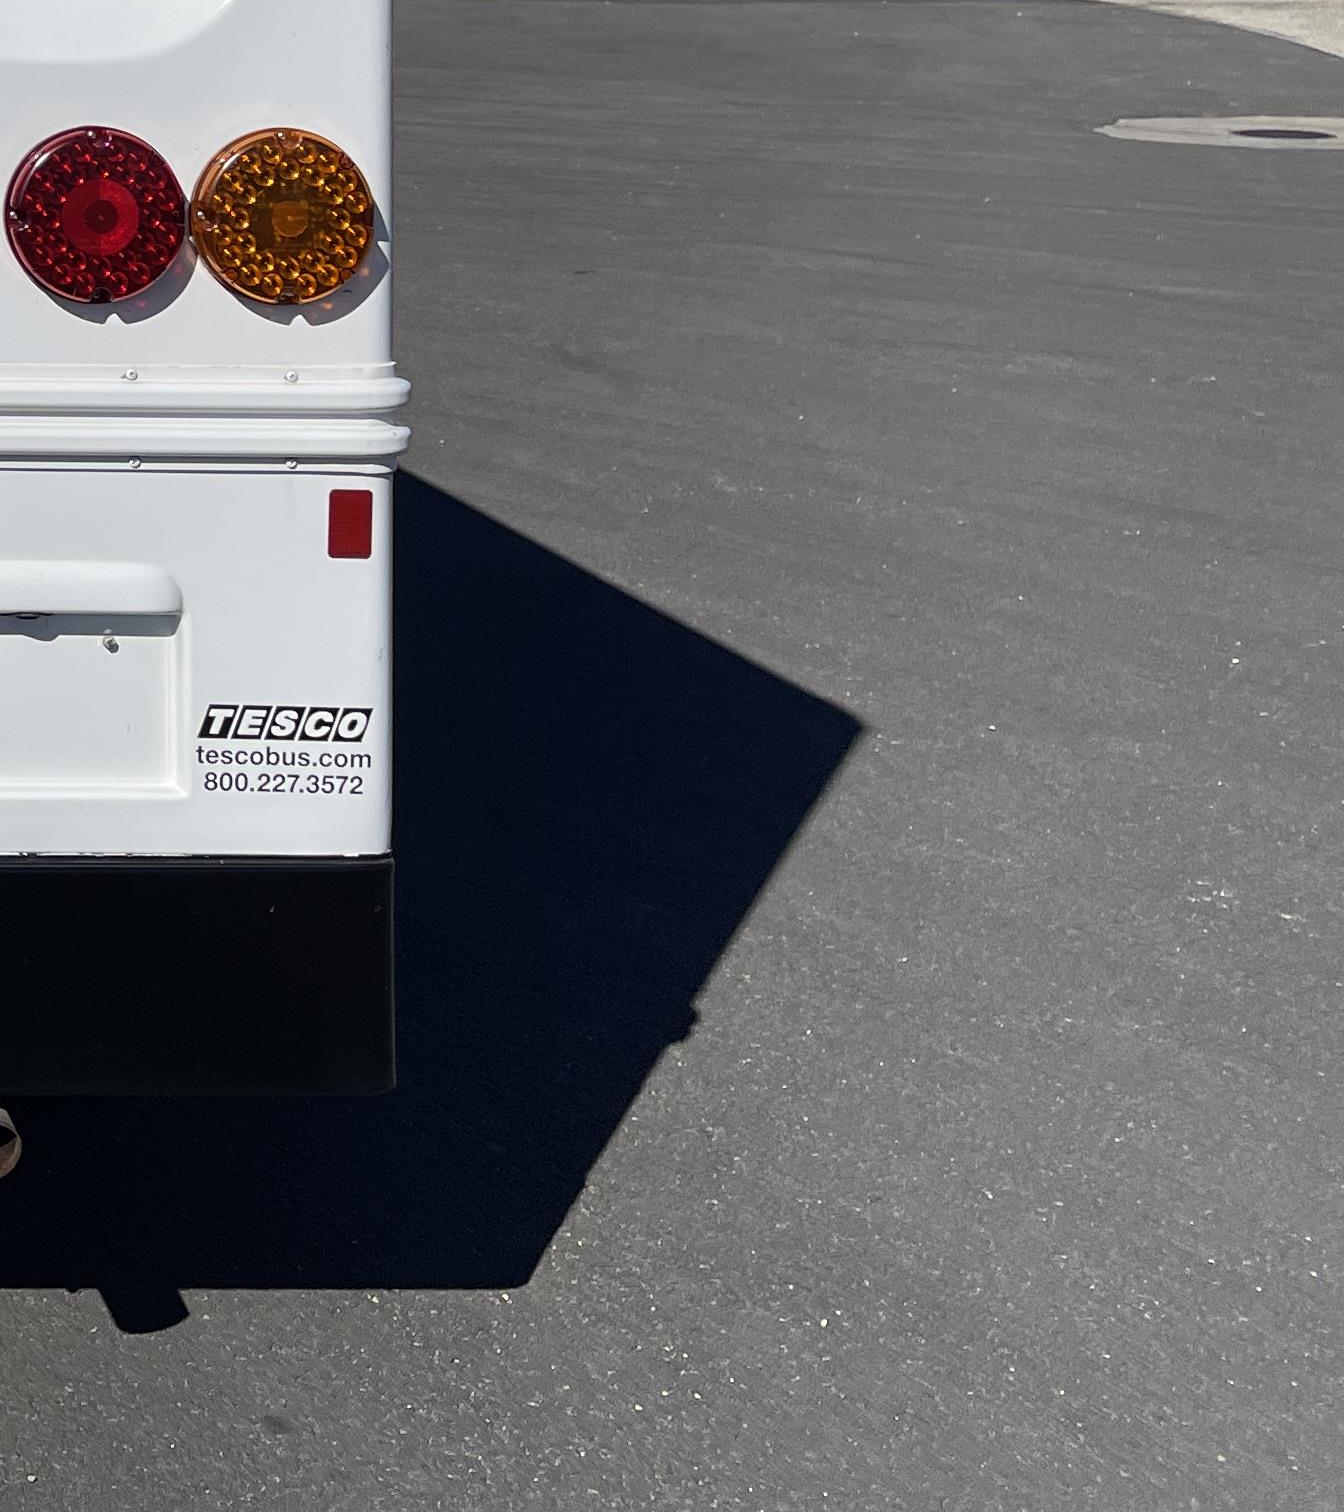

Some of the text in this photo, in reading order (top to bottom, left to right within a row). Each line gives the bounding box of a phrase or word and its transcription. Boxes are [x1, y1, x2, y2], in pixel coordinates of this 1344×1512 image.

[202, 705, 371, 741] TESCO
[196, 745, 372, 769] tescobus.com
[204, 772, 364, 795] 800.227.3572
